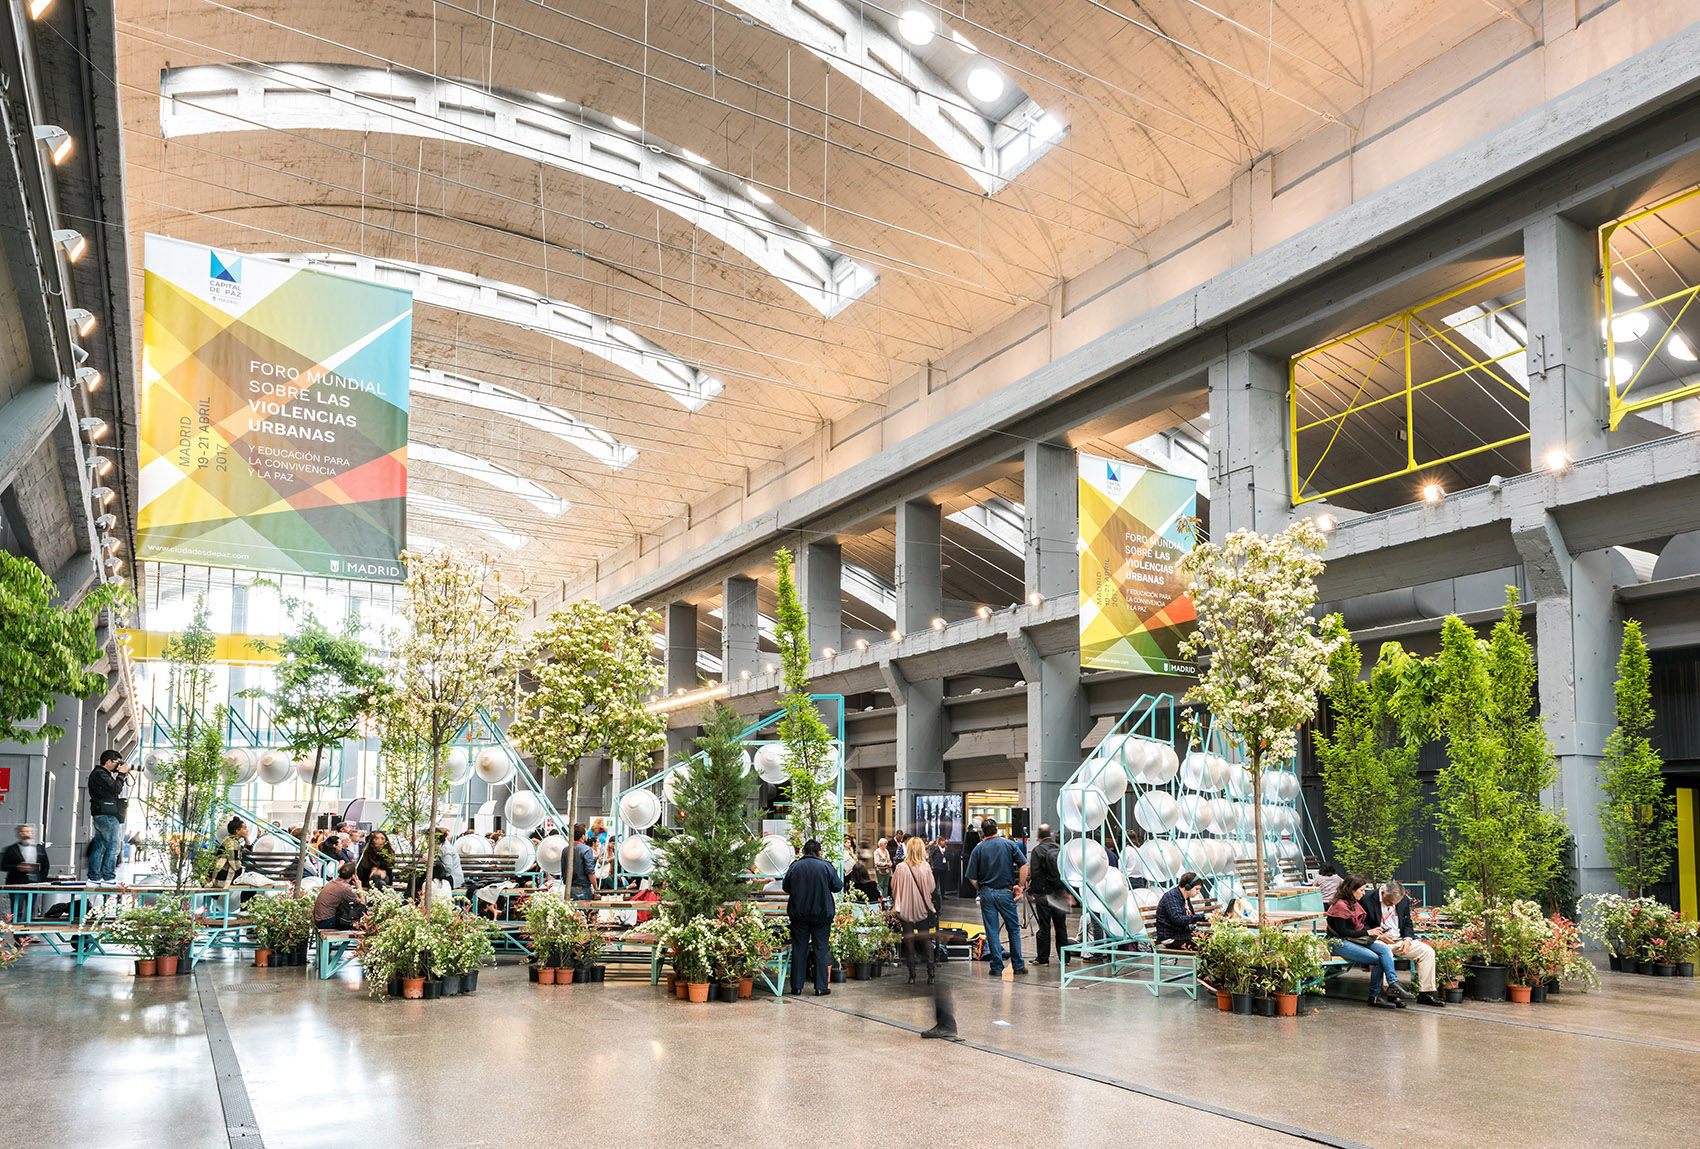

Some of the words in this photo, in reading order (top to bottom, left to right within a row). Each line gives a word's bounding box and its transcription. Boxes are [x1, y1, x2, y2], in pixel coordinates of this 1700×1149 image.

[209, 279, 242, 291] CAPITAL
[209, 286, 221, 294] DE
[225, 289, 242, 298] PAZ
[250, 360, 300, 380] FORO
[307, 370, 387, 396] MUNDIAL
[249, 380, 311, 402] SOBRE
[317, 391, 351, 408] LAS
[199, 396, 211, 433] ABRIL
[248, 399, 358, 428] VIOLENCIAS
[248, 418, 336, 443] URBANAS
[179, 416, 192, 467] MADRID
[215, 443, 228, 472] 2017
[248, 444, 256, 453] Y
[258, 446, 321, 463] EDUCACIÓN
[324, 455, 351, 467] PARA
[248, 456, 262, 467] LA
[264, 458, 337, 476] CONVIVENCIA
[248, 468, 256, 477] Y
[257, 469, 272, 479] LA
[274, 471, 294, 482] PAZ
[1125, 532, 1148, 544] FORO
[1150, 537, 1186, 551] MUNDIAL
[1125, 545, 1153, 558] SOBRE
[1155, 550, 1170, 561] LAS
[347, 562, 400, 576] MADRID
[1125, 558, 1174, 574] VIOLENCIAS
[1125, 571, 1165, 585] URBANAS
[1133, 597, 1166, 607] CONVIVENCIA
[1159, 592, 1171, 600] PARA
[1171, 664, 1196, 674] MADRID
